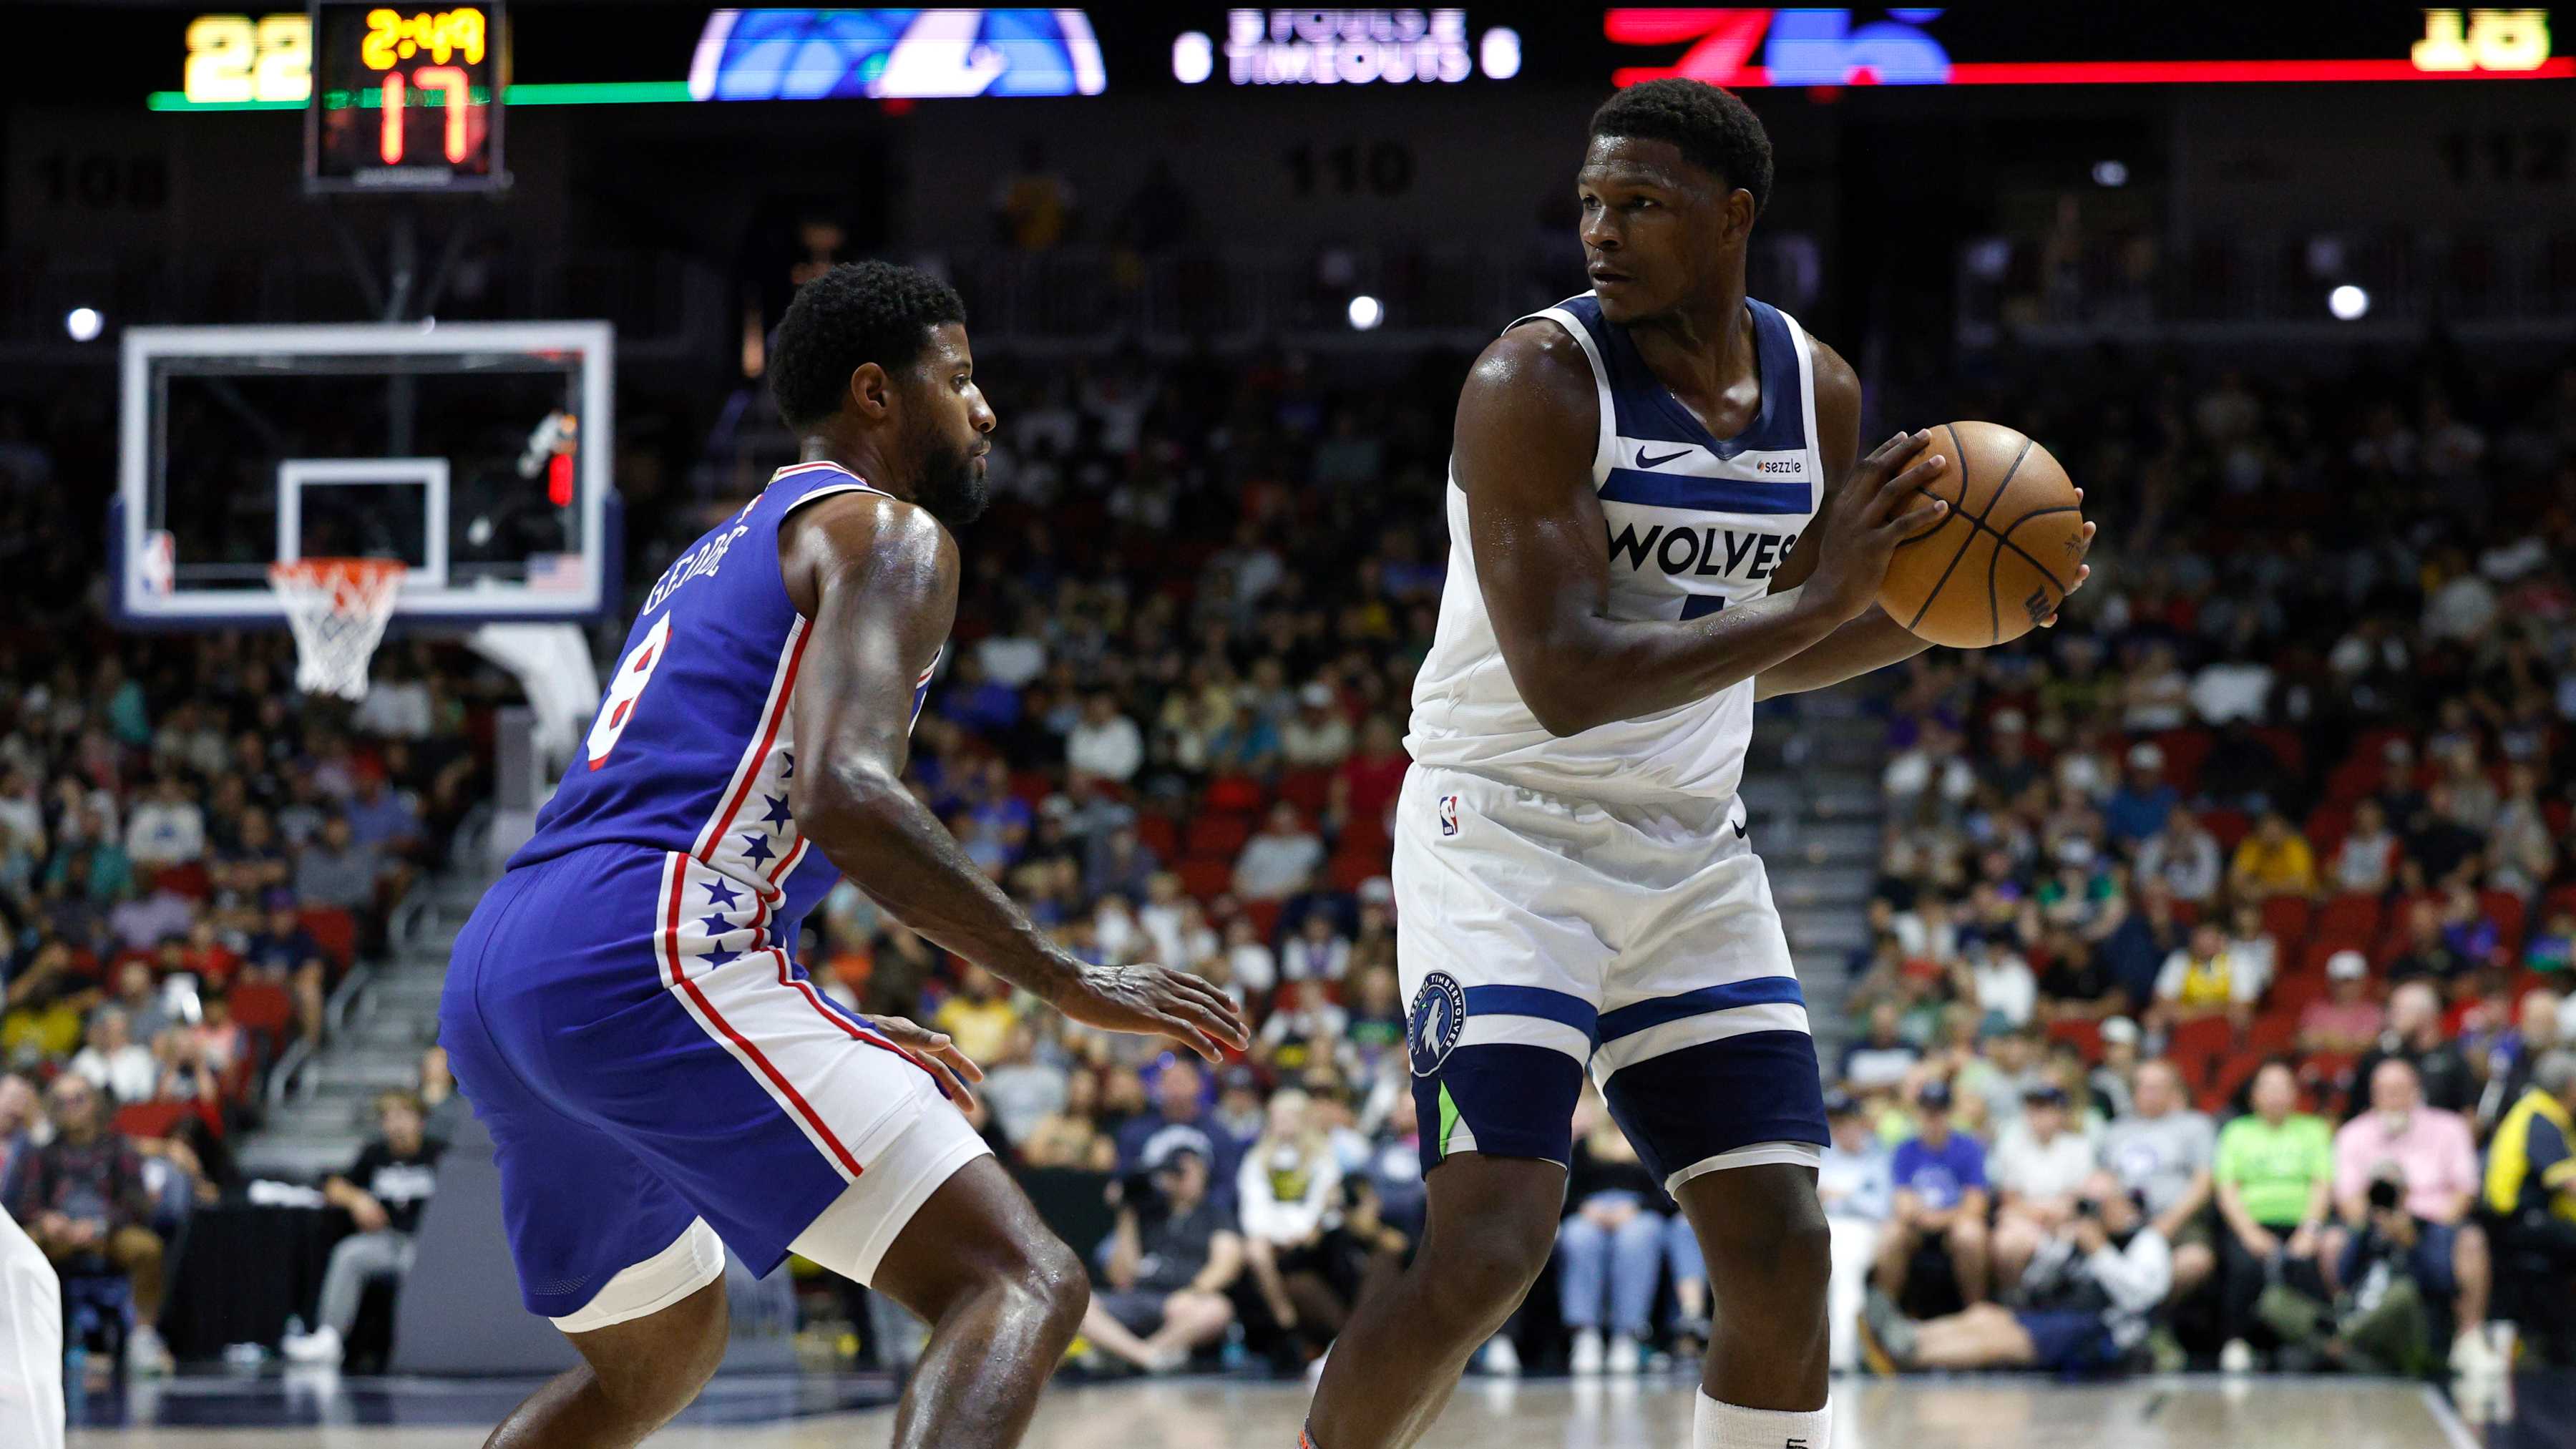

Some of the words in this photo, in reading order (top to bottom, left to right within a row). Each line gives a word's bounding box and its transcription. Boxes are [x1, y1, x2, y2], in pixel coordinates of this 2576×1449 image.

[185, 13, 312, 102] 22
[362, 8, 485, 69] 2:49
[381, 66, 469, 164] 17
[1765, 458, 1802, 473] sezzle
[587, 610, 673, 771] 8
[1430, 975, 1463, 1048] TIMBERWOLVES
